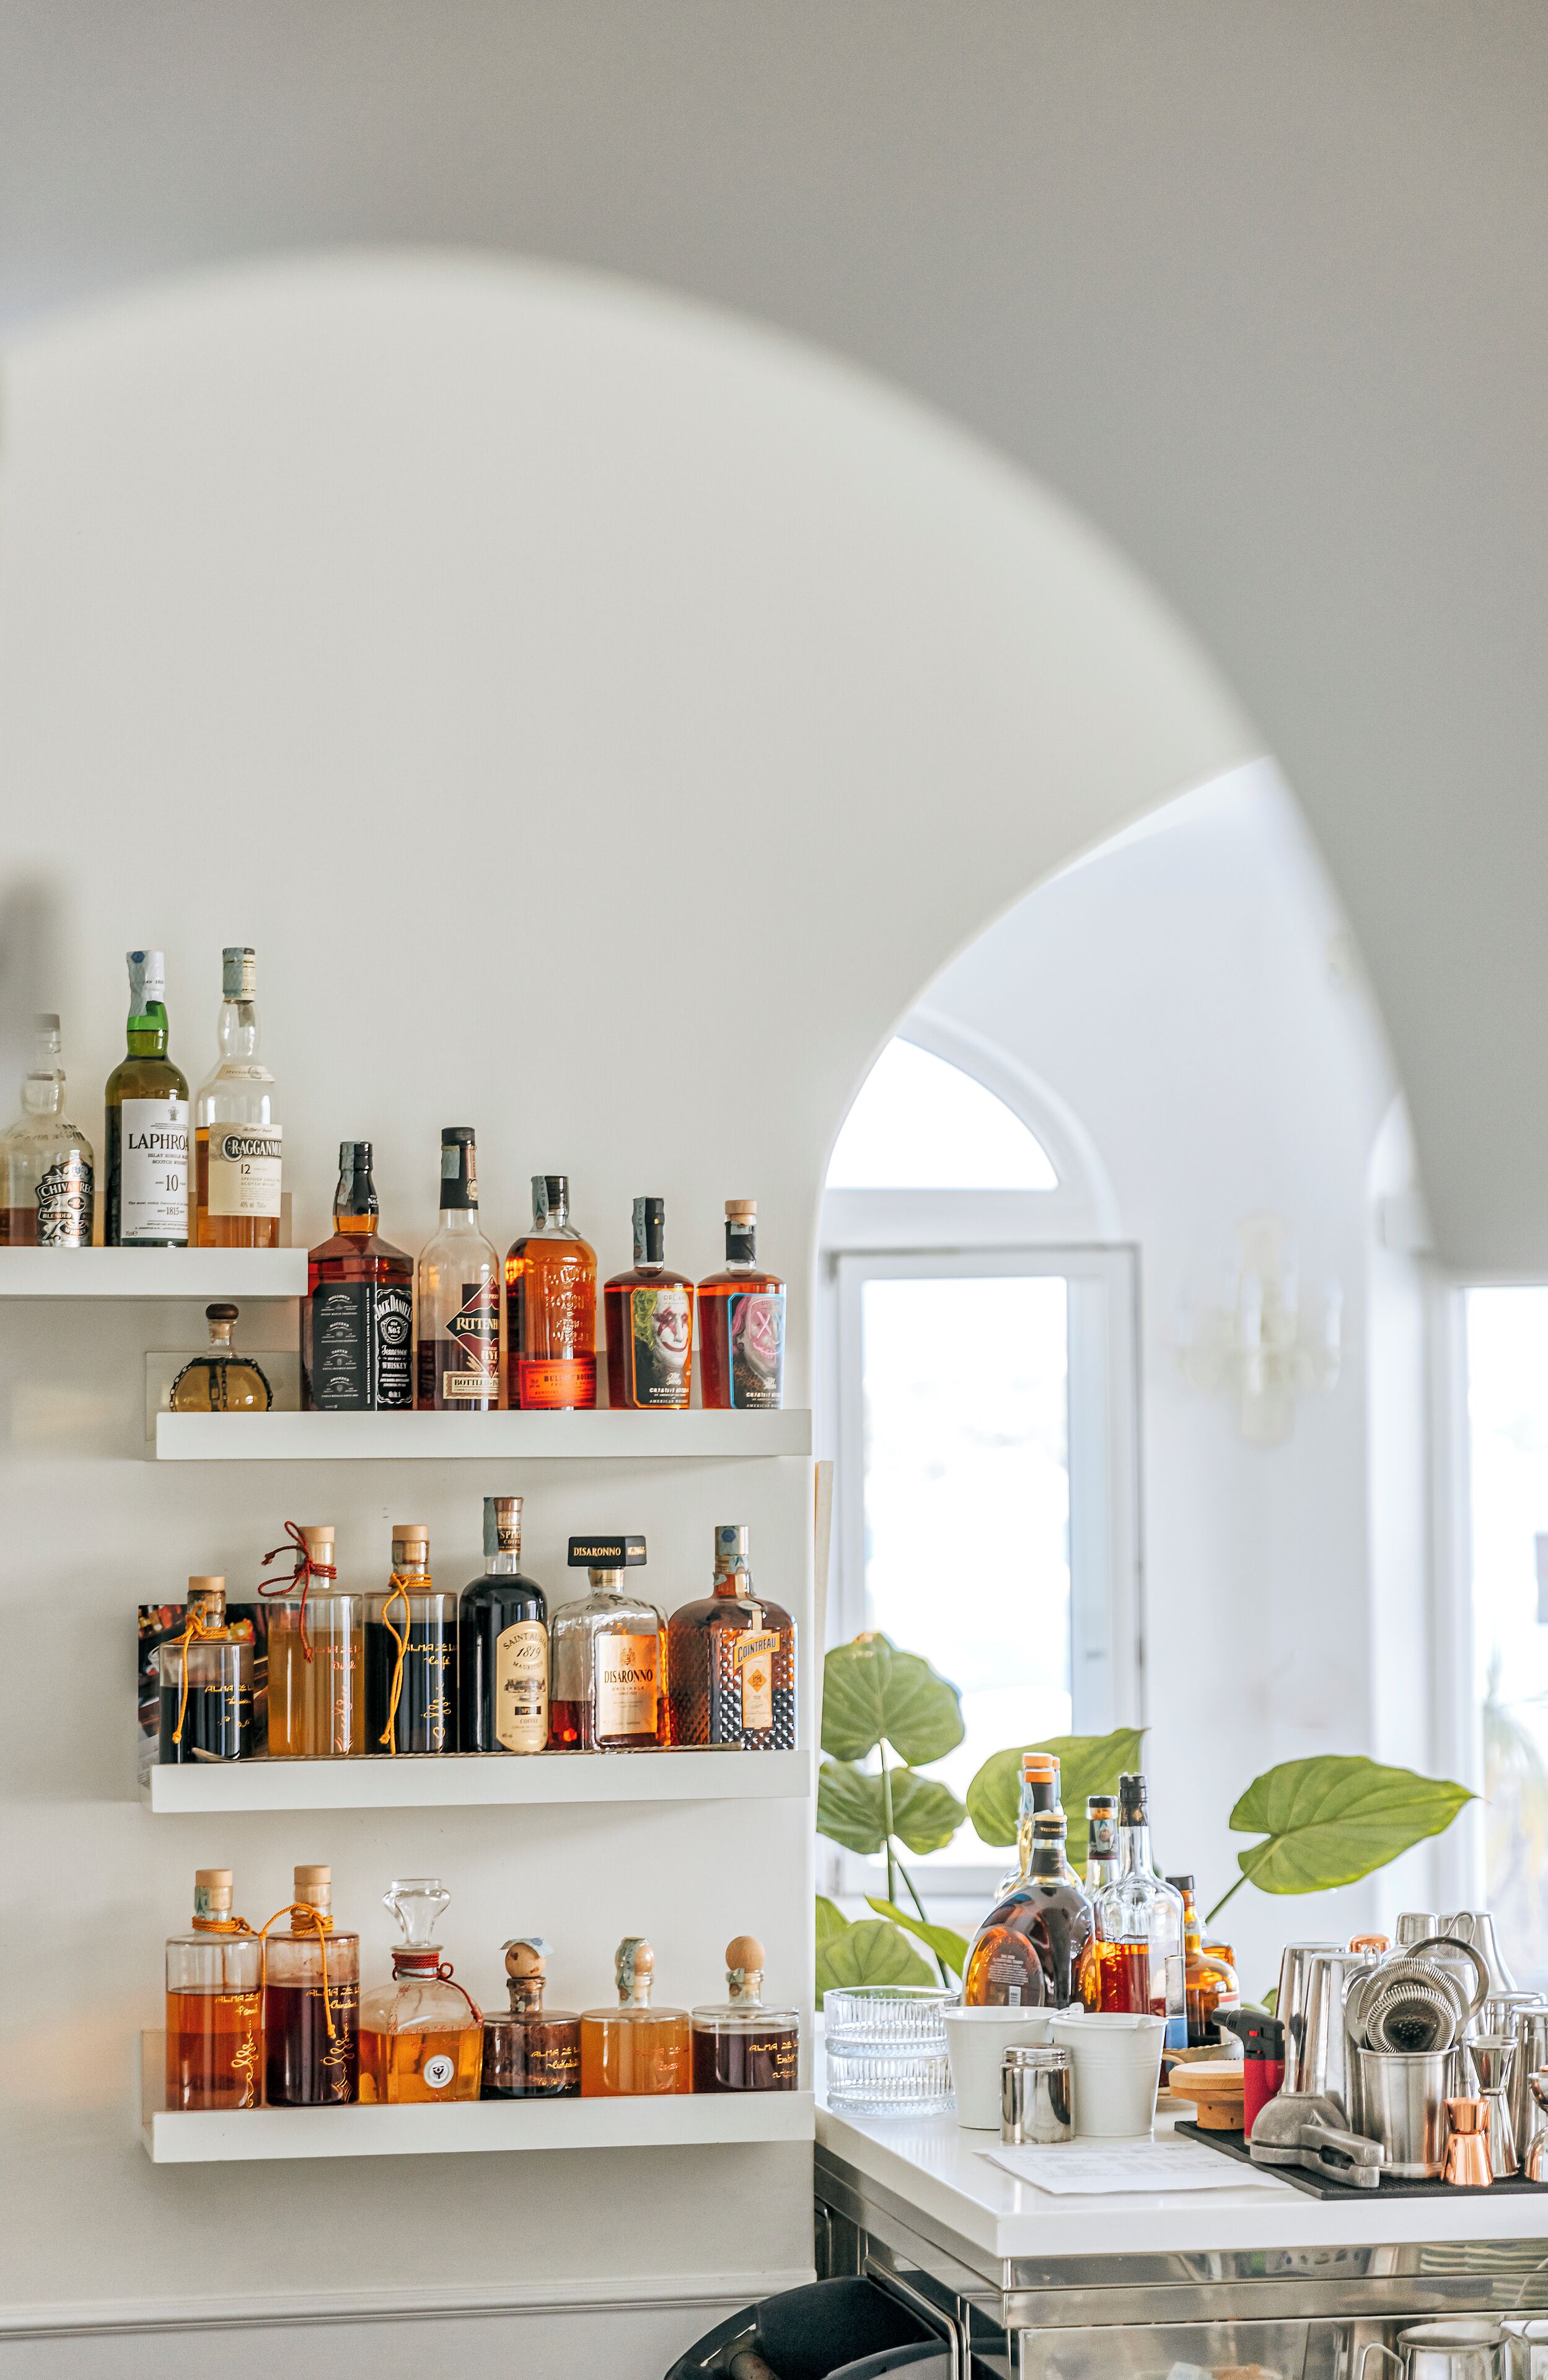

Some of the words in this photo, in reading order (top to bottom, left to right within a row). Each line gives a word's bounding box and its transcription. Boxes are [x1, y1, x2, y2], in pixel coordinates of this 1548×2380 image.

[240, 1164, 251, 1174] 12
[165, 1175, 178, 1191] 10
[166, 1207, 179, 1215] 1815
[373, 1298, 390, 1321] JACK
[388, 1326, 401, 1334] No.7
[381, 1344, 407, 1355] Tennessee
[573, 1546, 622, 1556] DISARONNO
[503, 1633, 529, 1651] SAINT
[517, 1646, 541, 1659] 1819
[737, 1636, 776, 1663] COINTREAU
[604, 1668, 653, 1683] DISARONNO
[215, 1994, 244, 2003] ALMA
[749, 2043, 778, 2052] ALMA
